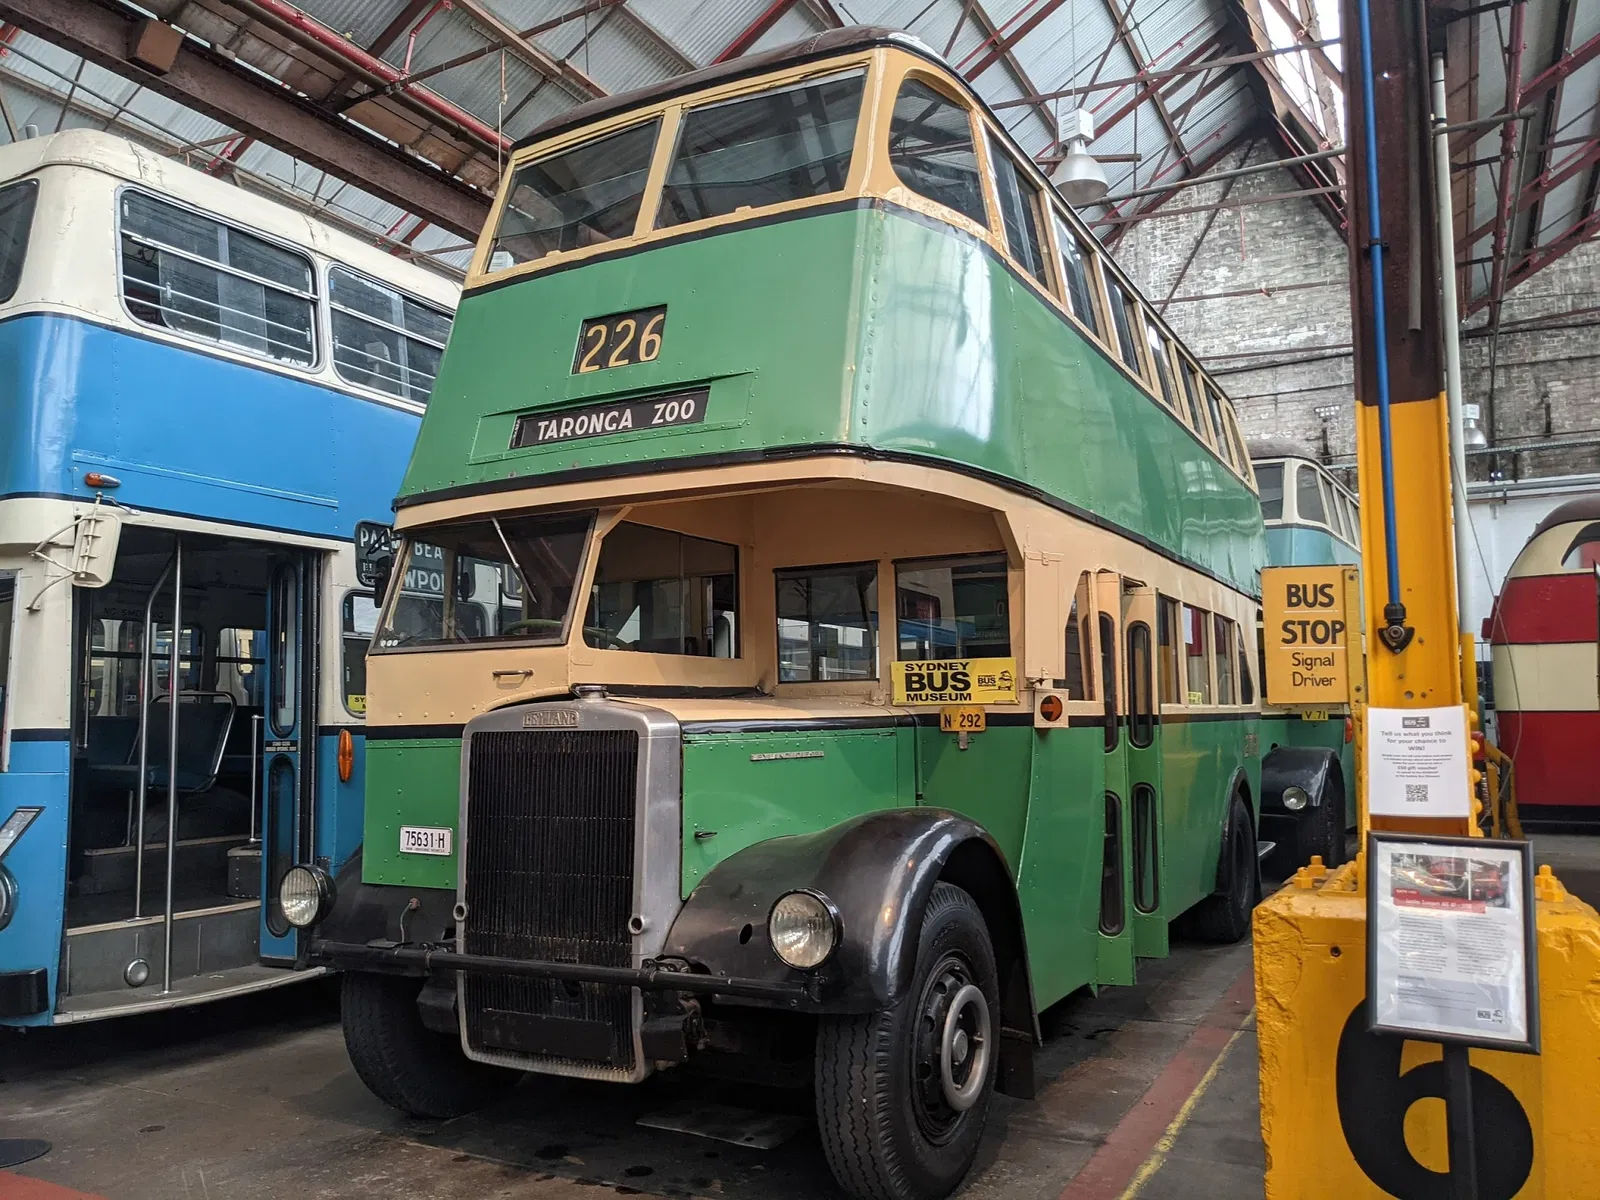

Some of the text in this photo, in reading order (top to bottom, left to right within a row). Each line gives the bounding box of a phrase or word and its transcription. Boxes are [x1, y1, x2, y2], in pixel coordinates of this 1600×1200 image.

[580, 314, 664, 373] 226
[538, 399, 695, 440] TARONGA ZOO
[414, 541, 443, 560] BEA
[1286, 584, 1335, 608] BUS
[1281, 620, 1345, 645] STOP
[905, 662, 969, 671] SYDNEY
[1292, 652, 1335, 670] Signal
[905, 672, 971, 692] BUS
[1292, 671, 1337, 687] Driver
[906, 693, 971, 702] MUSEUM
[1336, 997, 1534, 1200] 6
